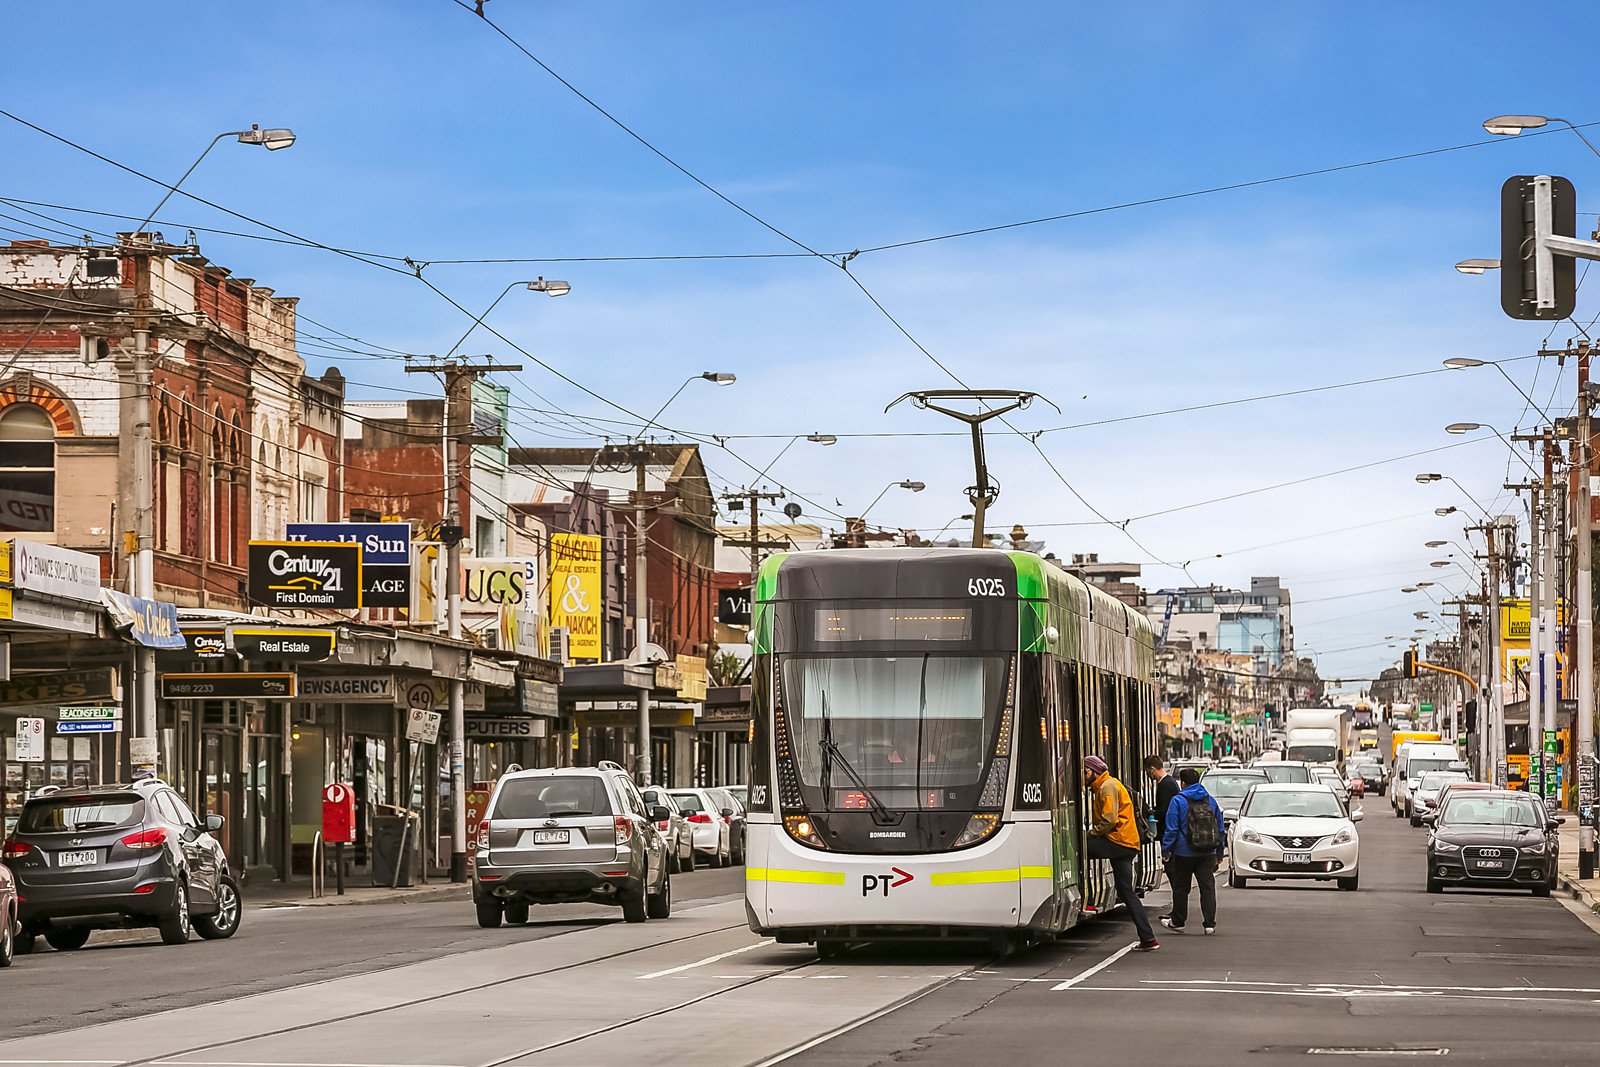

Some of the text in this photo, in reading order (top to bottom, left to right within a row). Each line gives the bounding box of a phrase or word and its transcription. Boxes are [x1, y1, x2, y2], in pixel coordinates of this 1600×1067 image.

[365, 534, 406, 553] Sun
[268, 549, 330, 577] Century
[555, 565, 597, 574] REAL ESTATE
[371, 580, 405, 593] AGE
[459, 568, 523, 605] UGS
[967, 578, 1006, 597] 6025
[276, 592, 334, 603] First Domain
[561, 574, 590, 613] &
[146, 603, 171, 642] Cycles
[194, 636, 222, 648] Century
[259, 641, 310, 653] Real Estate
[169, 681, 214, 693] 9489 2233
[411, 691, 429, 704] 40
[60, 708, 108, 718] BEACONSFIELD
[1022, 783, 1042, 803] 6025
